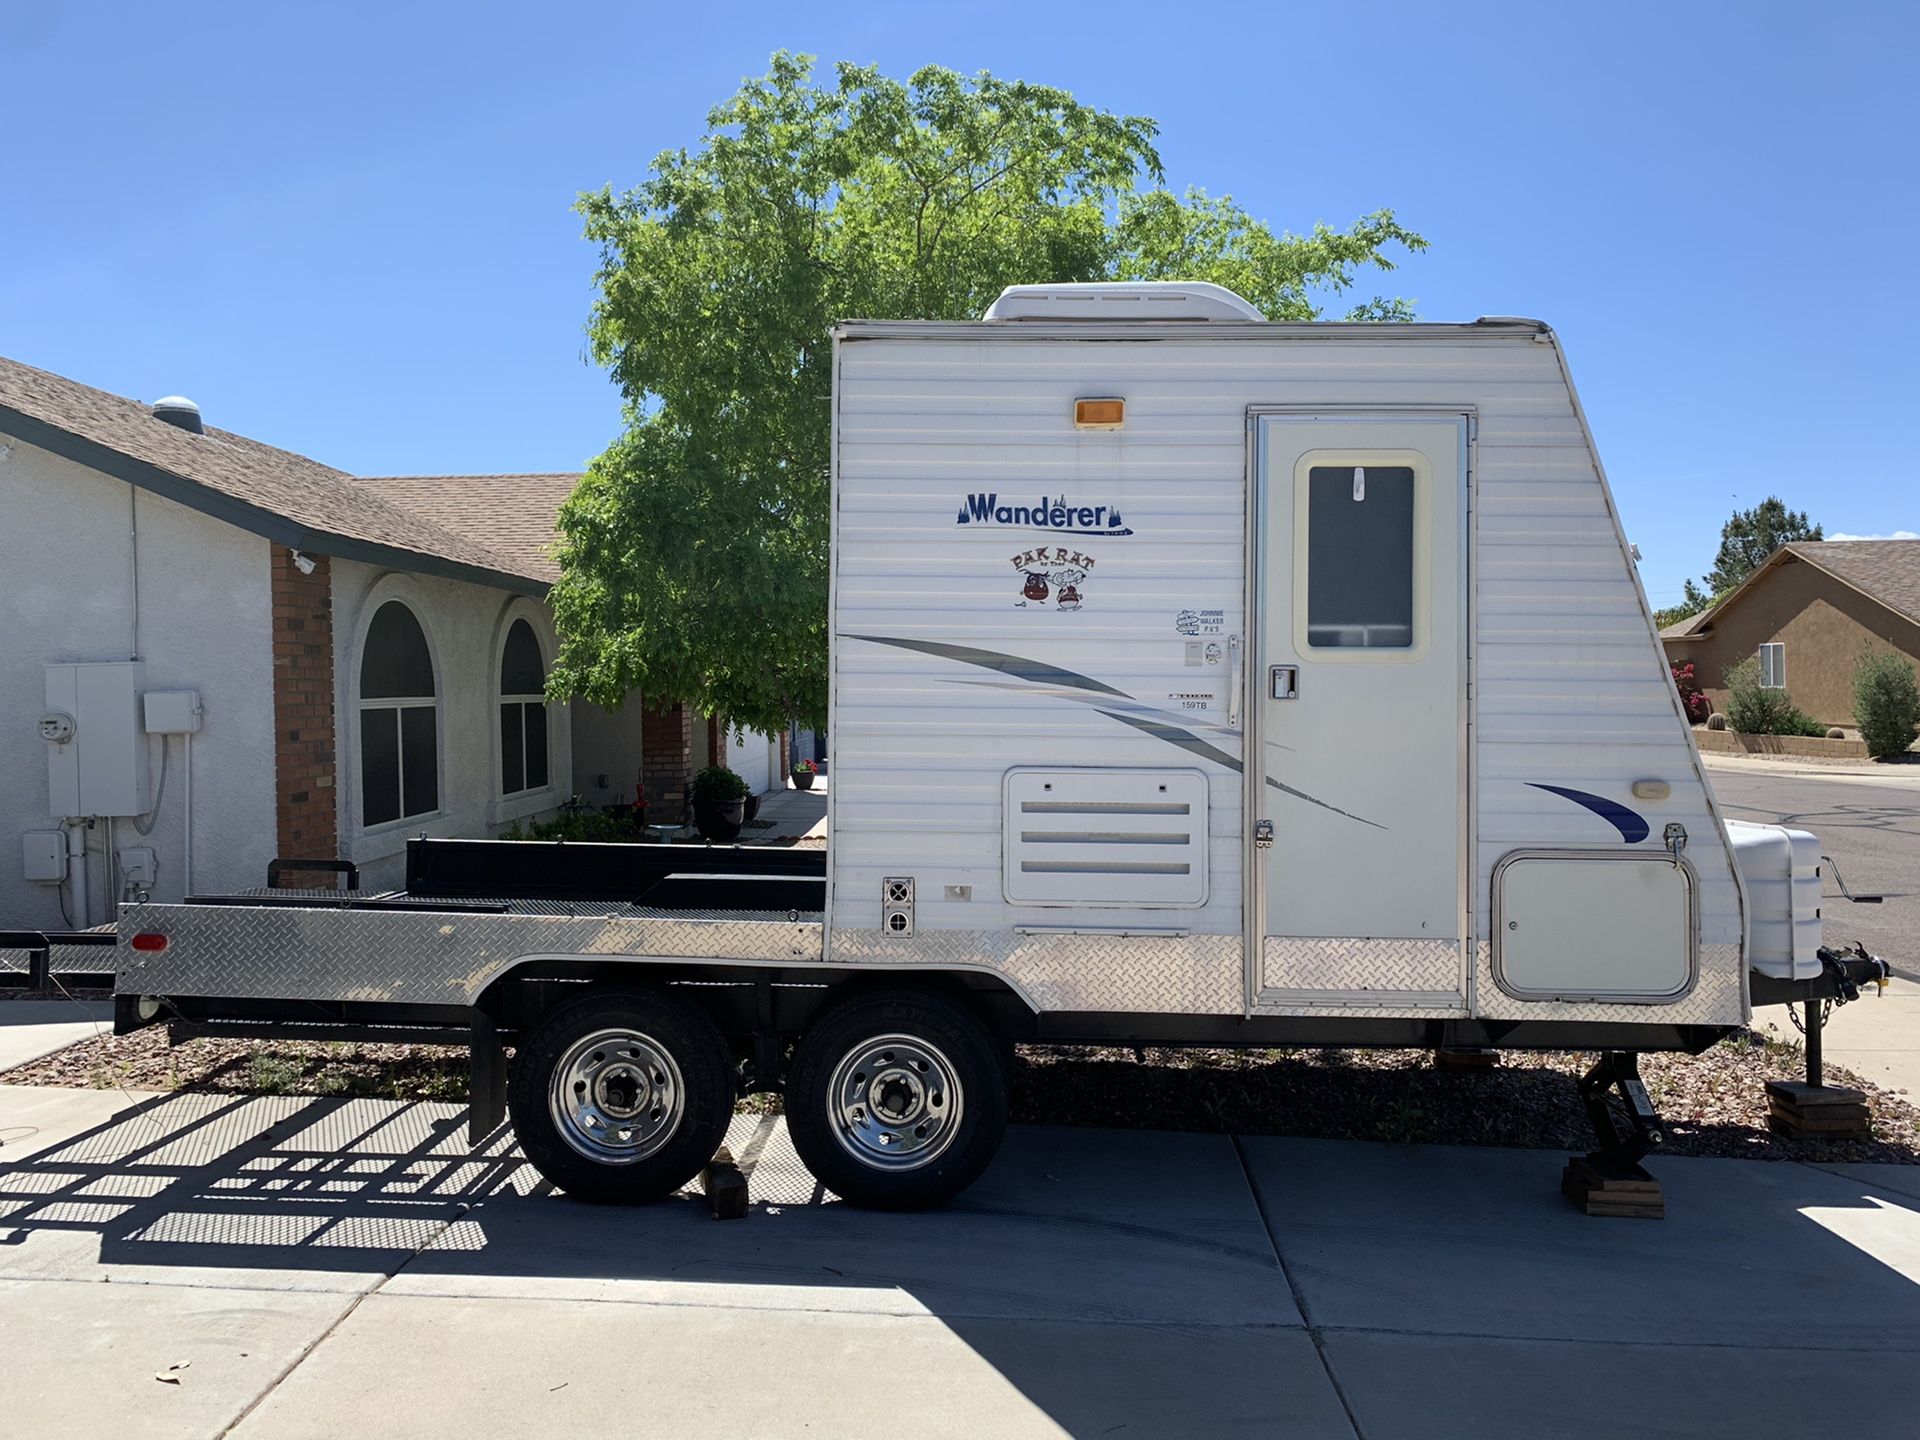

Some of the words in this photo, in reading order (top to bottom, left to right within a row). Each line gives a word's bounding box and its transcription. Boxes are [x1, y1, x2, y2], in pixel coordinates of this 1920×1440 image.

[967, 493, 1106, 527] Wanderer
[1010, 546, 1049, 571] PAK
[1055, 547, 1096, 572] RAT
[1182, 701, 1207, 710] 159TB
